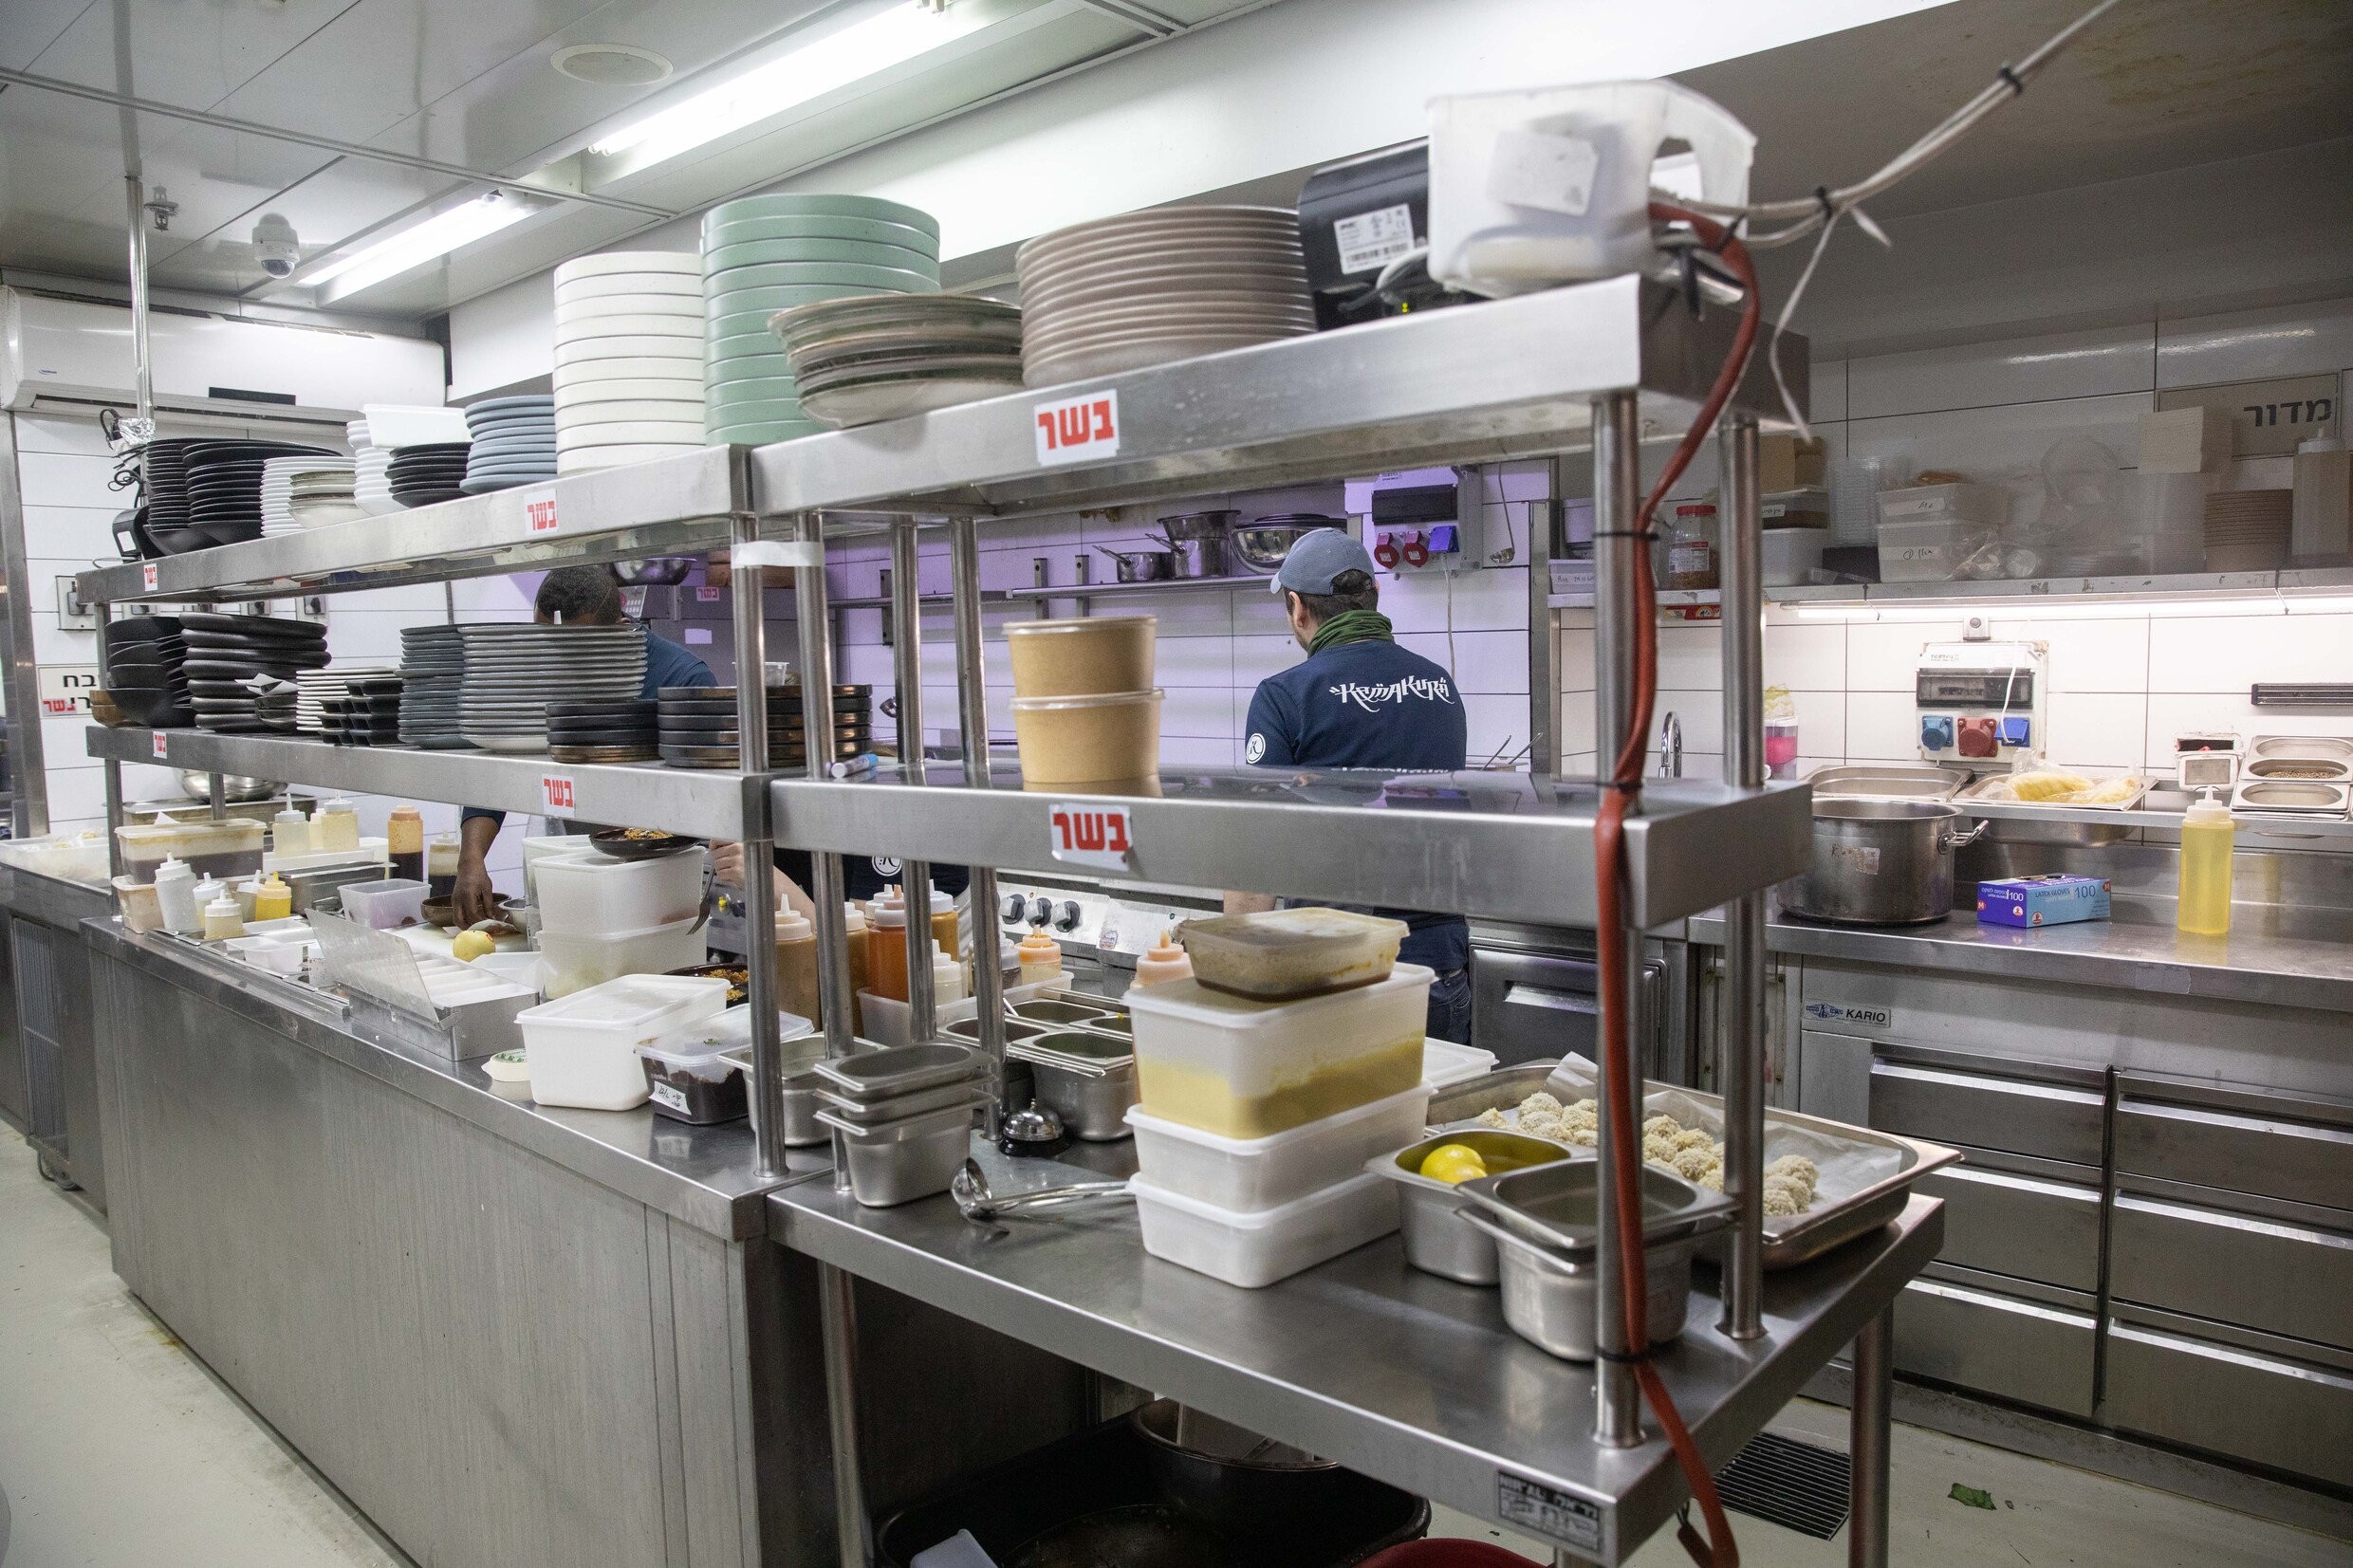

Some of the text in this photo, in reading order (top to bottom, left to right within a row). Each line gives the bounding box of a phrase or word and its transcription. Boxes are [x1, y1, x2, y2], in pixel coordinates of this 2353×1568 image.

[2244, 398, 2332, 427] מדור
[1038, 400, 1114, 450] בשר
[527, 500, 557, 531] בשר
[697, 588, 718, 599] בשר
[63, 674, 97, 688] בח
[543, 778, 574, 808] בשר
[1052, 813, 1129, 851] בשר
[2010, 892, 2024, 902] 100
[2075, 884, 2096, 898] 100
[1846, 1008, 1886, 1023] KARIO
